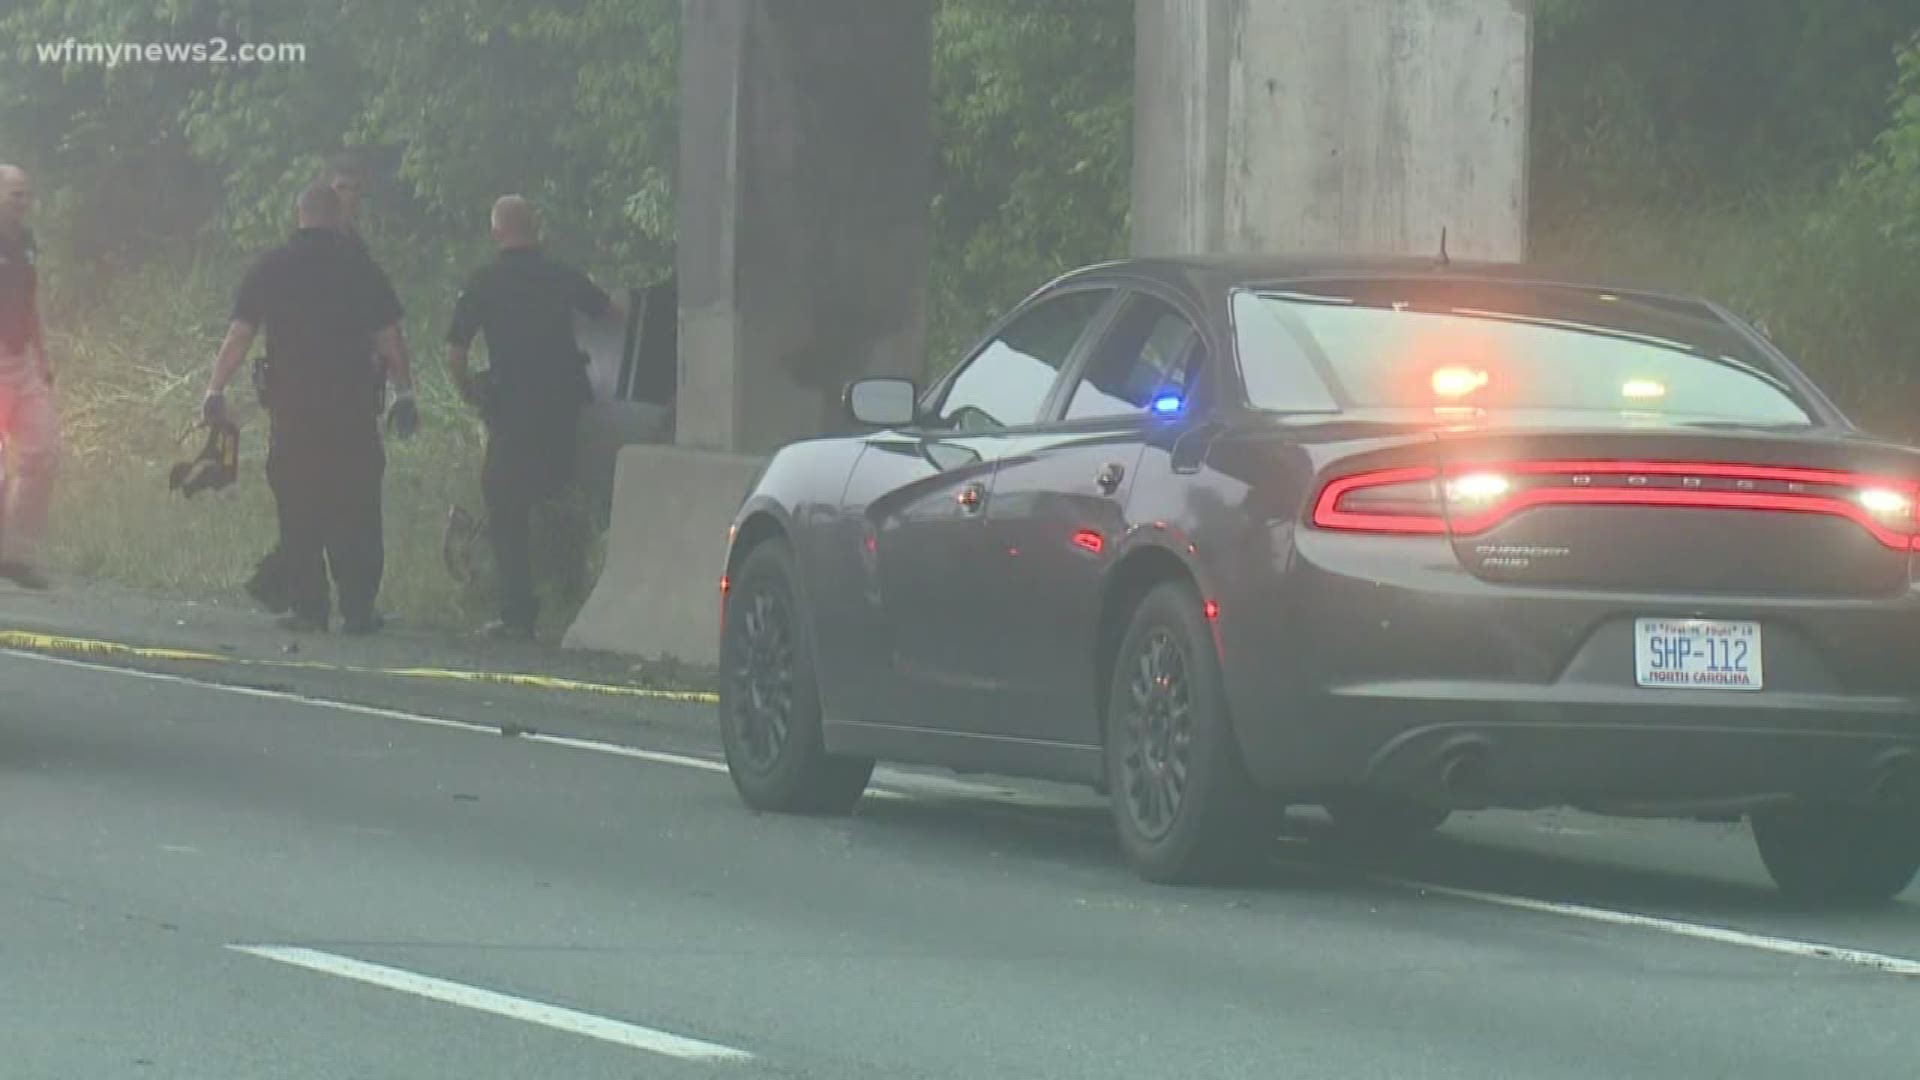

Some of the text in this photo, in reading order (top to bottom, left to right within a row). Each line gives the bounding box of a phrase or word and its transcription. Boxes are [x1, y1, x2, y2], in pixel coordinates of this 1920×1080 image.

[1650, 636, 1748, 672] SHP-112
[1649, 671, 1750, 684] NORTH CAROLINA
